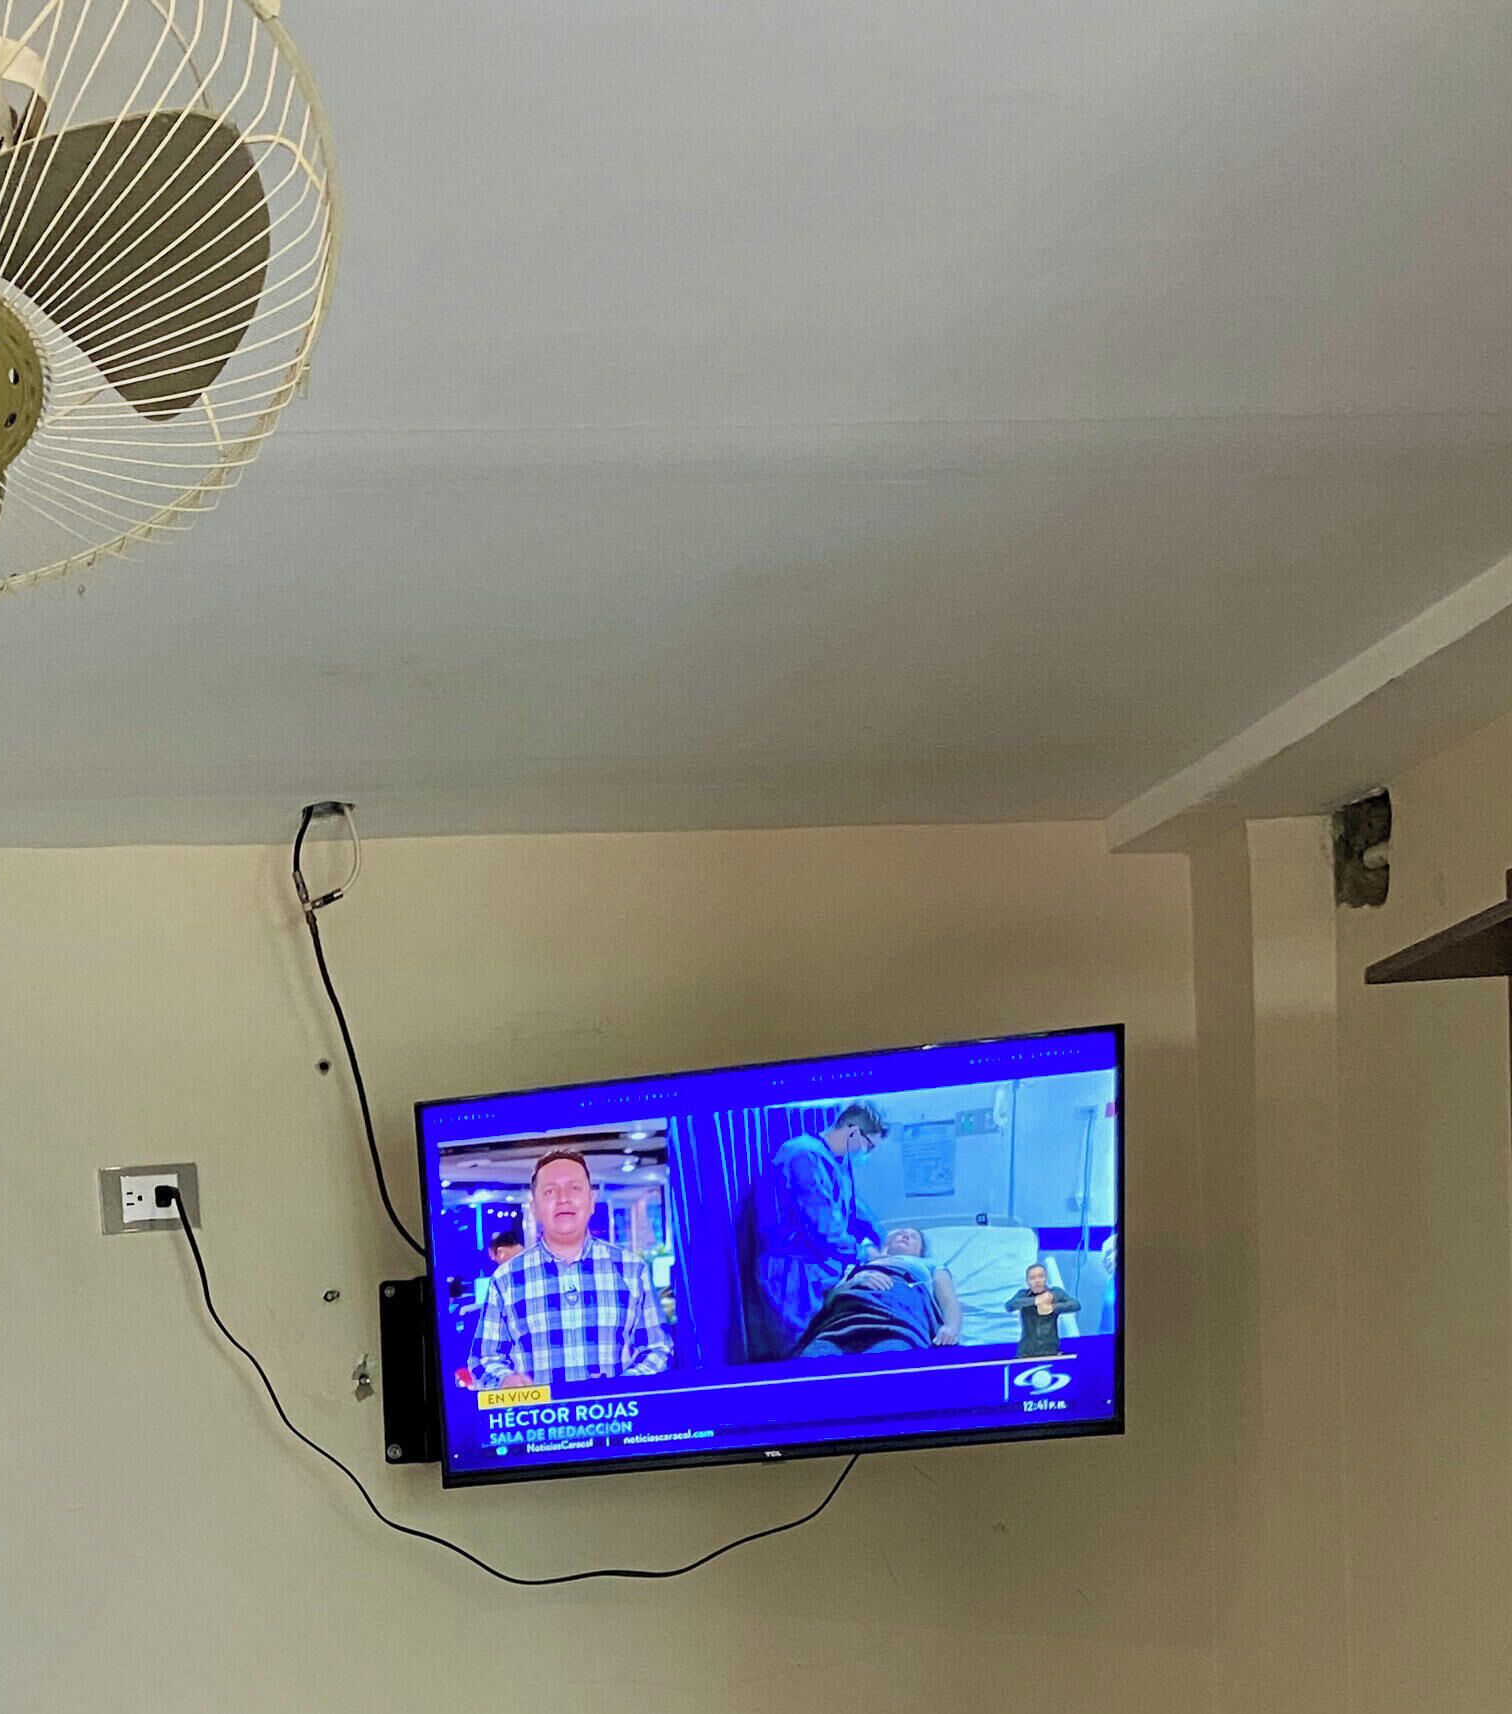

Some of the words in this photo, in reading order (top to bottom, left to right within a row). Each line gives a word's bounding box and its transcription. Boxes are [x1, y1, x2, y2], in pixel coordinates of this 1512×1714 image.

[488, 1393, 505, 1405] EN
[509, 1390, 540, 1403] VIVO
[489, 1408, 569, 1429] HÉCTOR
[576, 1401, 638, 1420] ROJAS
[490, 1430, 523, 1444] SALA
[527, 1428, 544, 1441] DE
[548, 1420, 632, 1439] REDACCIÓN
[527, 1438, 593, 1453] NoticiasCaracol
[623, 1429, 714, 1445] noticiascaracol.com
